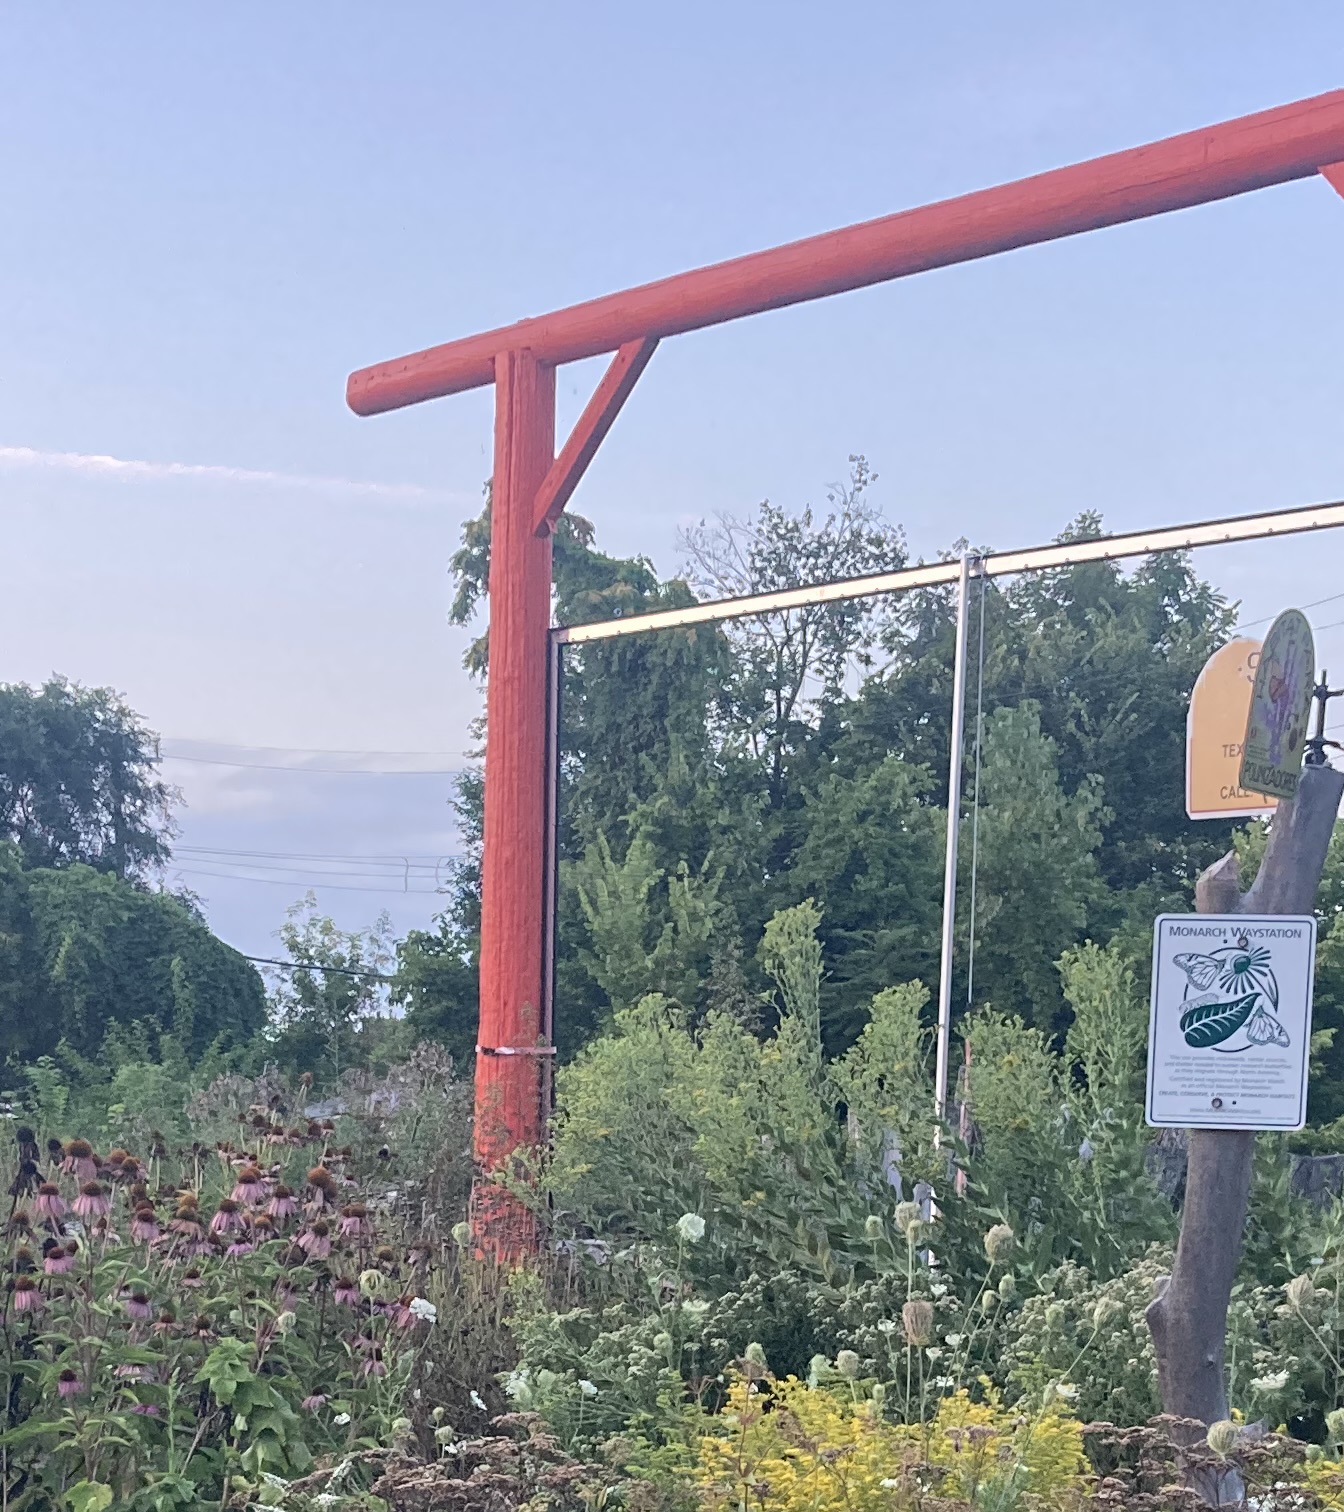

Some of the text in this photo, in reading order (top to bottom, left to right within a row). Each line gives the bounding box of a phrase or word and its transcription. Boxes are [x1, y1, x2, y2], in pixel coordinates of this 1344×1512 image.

[1222, 743, 1245, 758] TEX
[1169, 925, 1302, 939] MONARCH WAYSTATION
